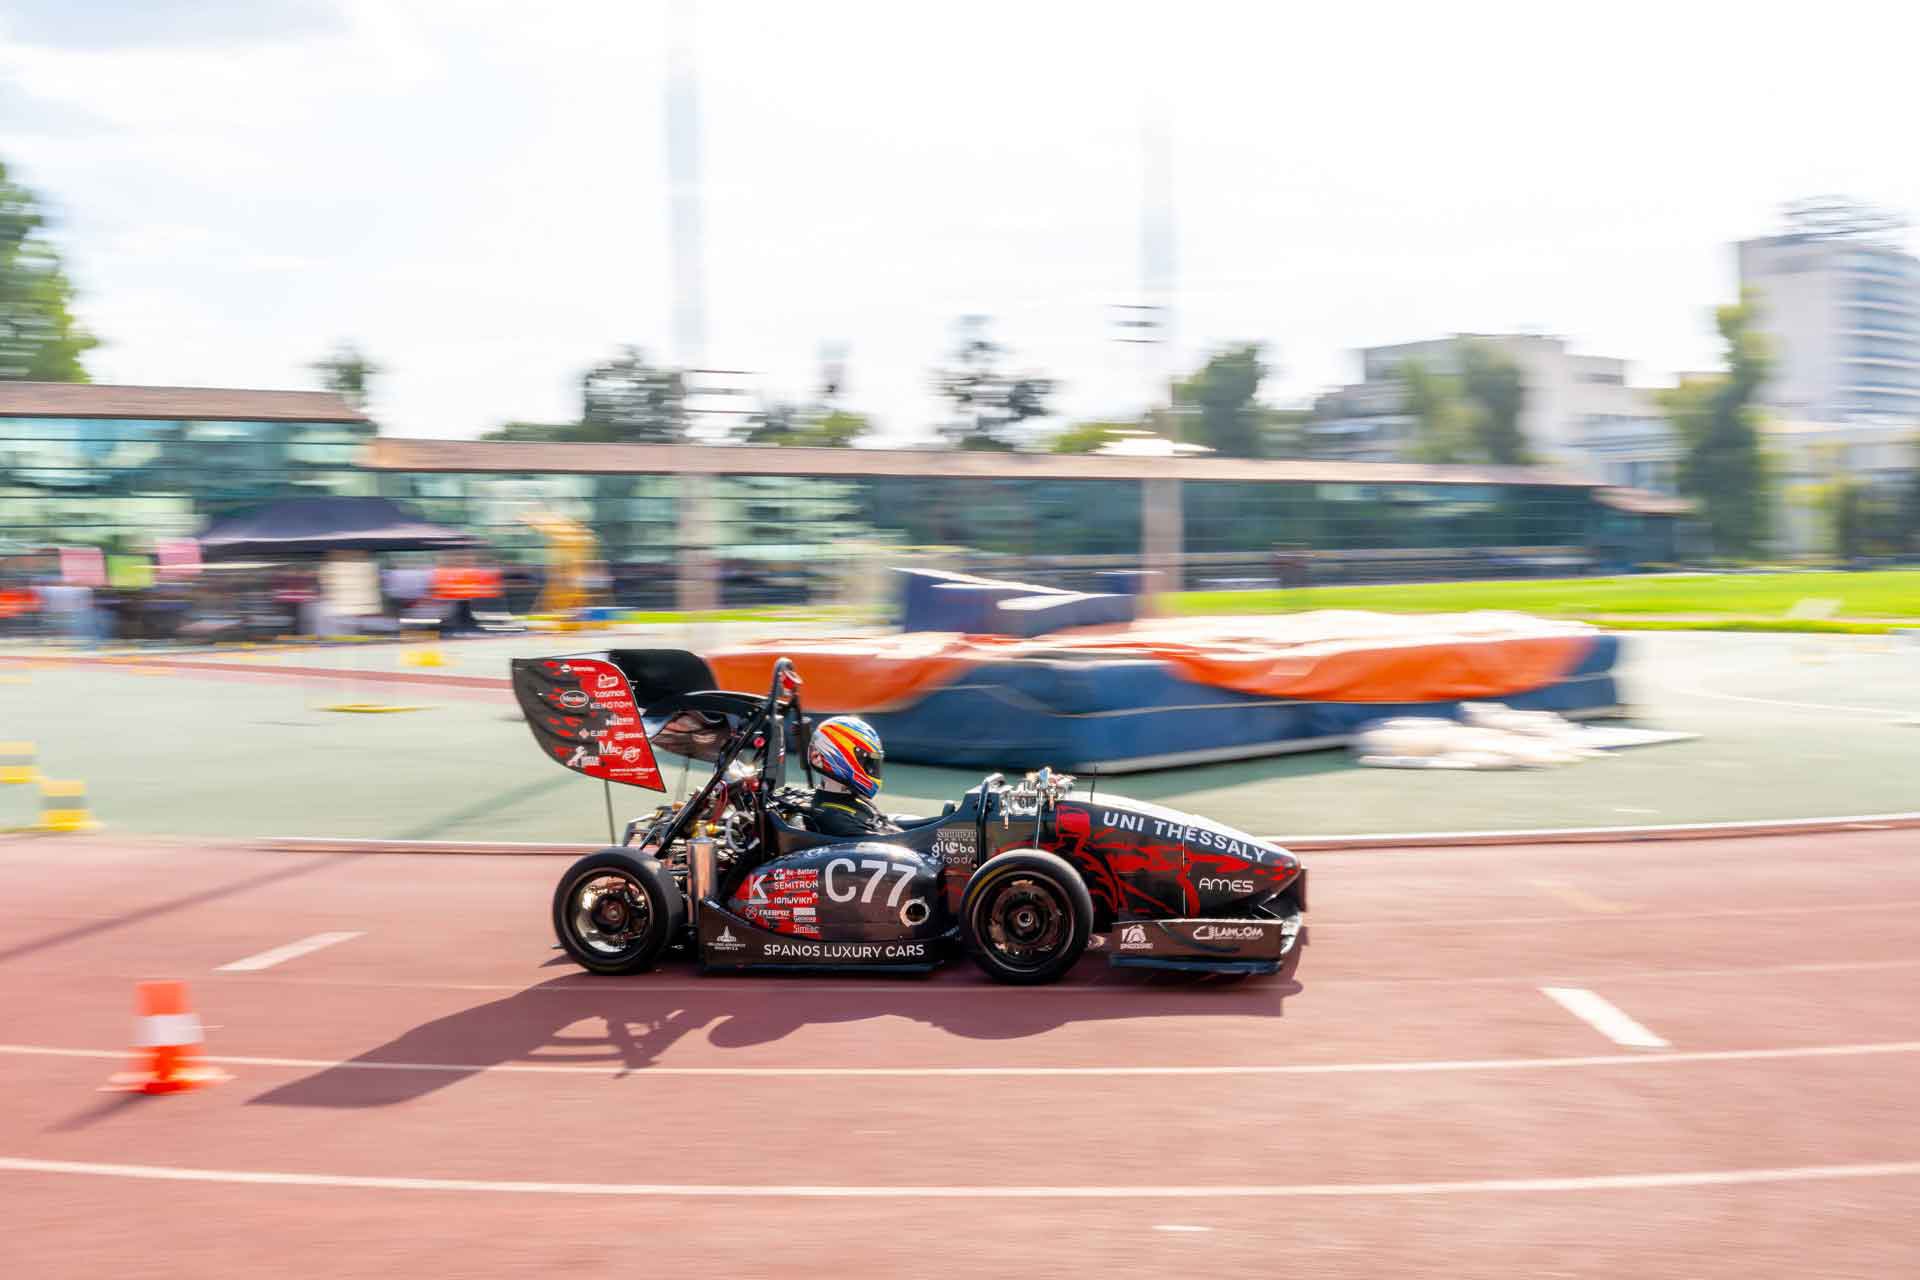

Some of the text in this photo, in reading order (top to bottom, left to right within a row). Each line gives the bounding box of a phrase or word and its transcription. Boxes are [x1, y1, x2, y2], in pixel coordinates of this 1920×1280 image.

[1102, 811, 1267, 863] UNI THESSALY
[774, 880, 818, 890] SEMITRON
[824, 857, 917, 908] C77
[1198, 878, 1254, 893] AMES
[763, 944, 925, 958] SPANOS LUXURY CARS
